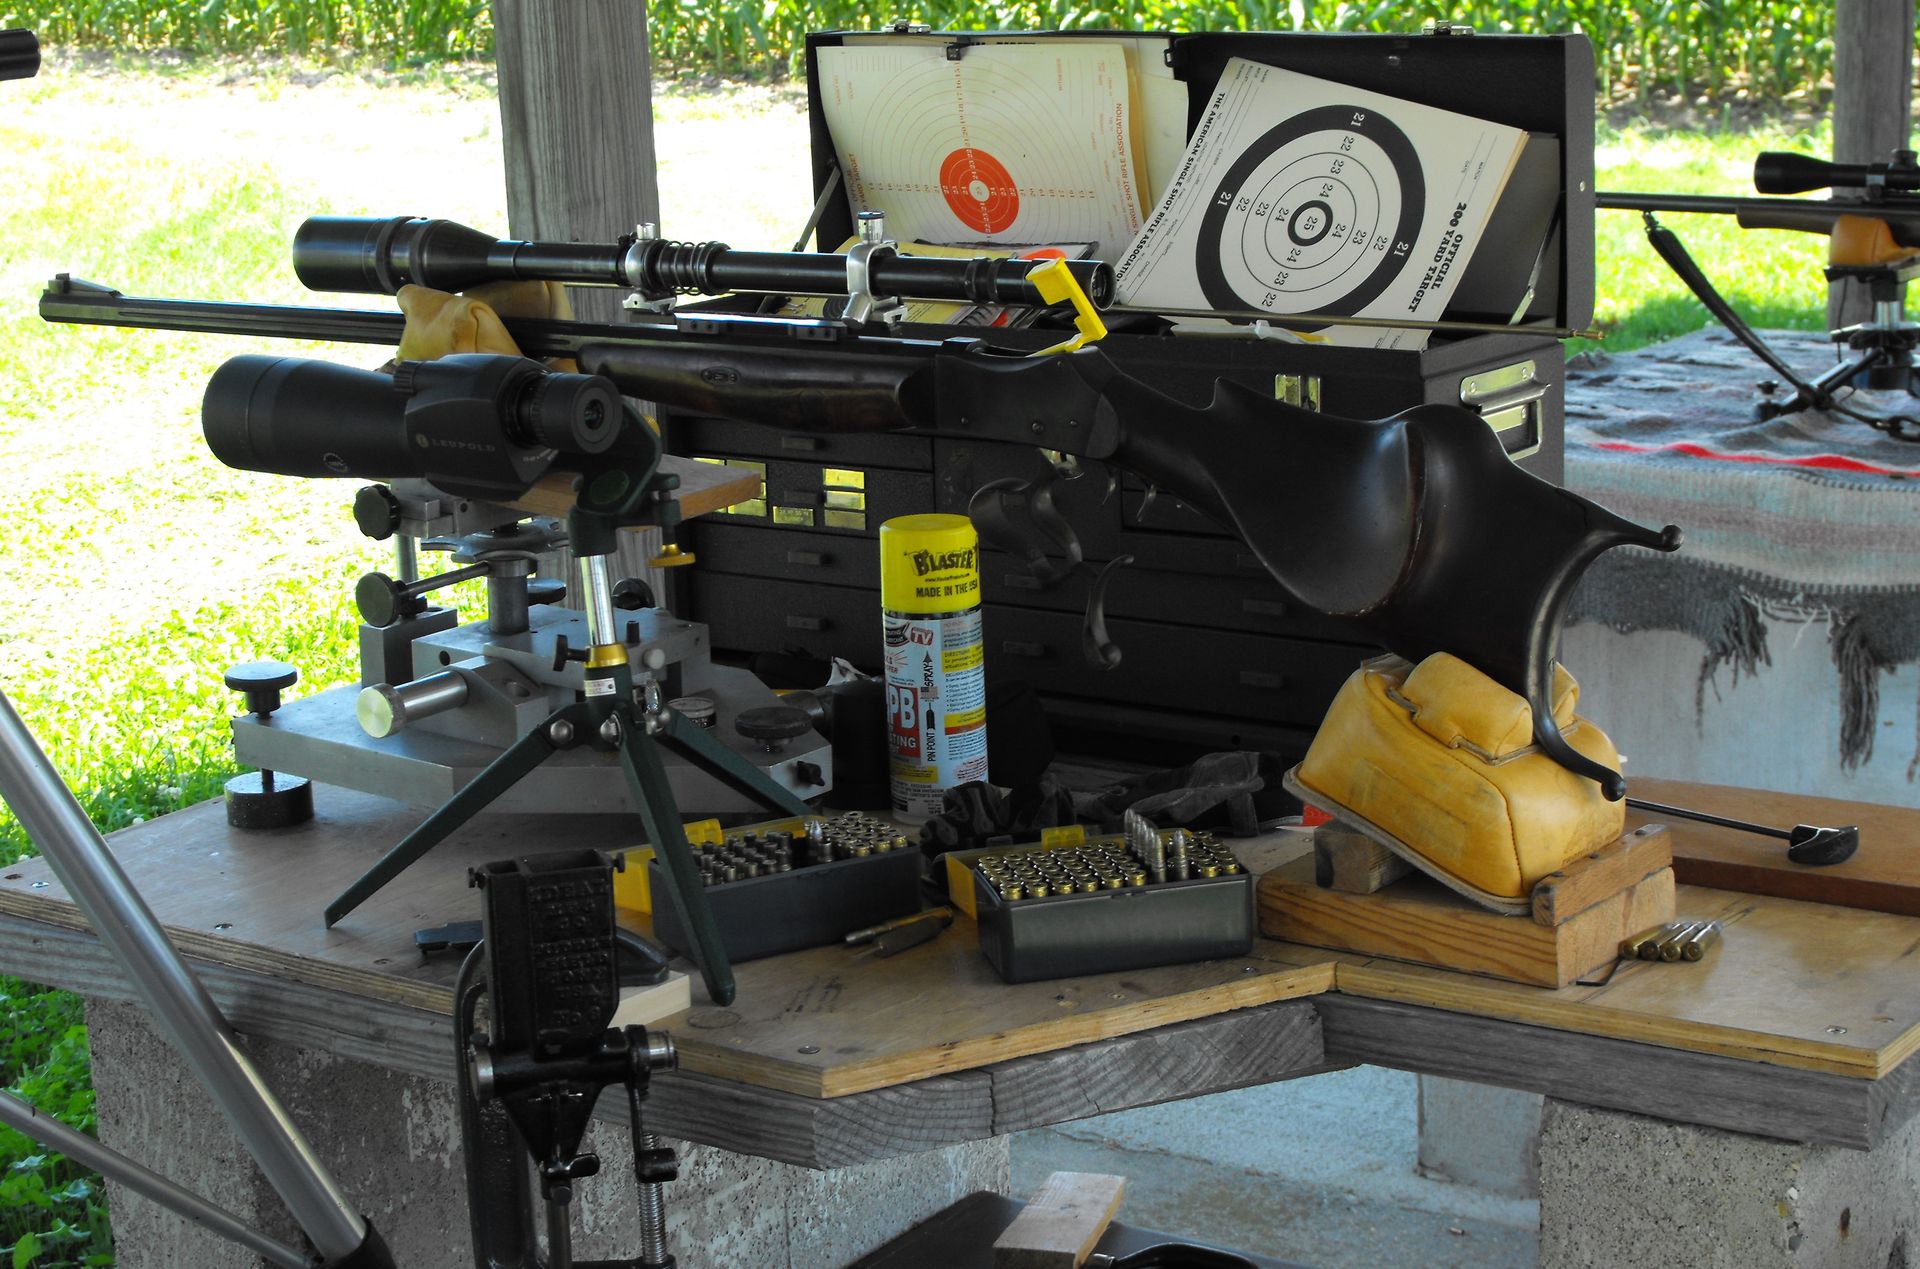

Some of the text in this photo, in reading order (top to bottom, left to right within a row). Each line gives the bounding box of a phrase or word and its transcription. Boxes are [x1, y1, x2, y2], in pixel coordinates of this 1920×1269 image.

[1213, 93, 1225, 109] THE
[1350, 111, 1365, 128] 21
[1114, 102, 1124, 156] ASSOCIATION
[1191, 111, 1216, 155] AMERICAN
[1340, 136, 1353, 151] 22
[1119, 157, 1128, 178] RIFLE
[1175, 157, 1193, 187] SINGLE
[1330, 159, 1344, 174] 23
[1123, 180, 1132, 200] SHOT
[1319, 183, 1333, 197] 24
[1163, 188, 1178, 210] SHOT
[1216, 190, 1231, 207] 21
[1236, 197, 1249, 211] 22
[1255, 202, 1269, 216] 23
[1275, 208, 1289, 221] 24
[1147, 212, 1164, 233] RIFLE
[1304, 216, 1317, 230] 25
[1332, 223, 1345, 238] 24
[1352, 230, 1366, 244] 23
[1373, 236, 1387, 251] 22
[1392, 240, 1409, 258] 21
[1287, 248, 1301, 262] 24
[1408, 202, 1466, 312] 200 YARD TARGET
[1431, 234, 1463, 289] OFFICIAL
[1274, 271, 1288, 285] 23
[1261, 292, 1276, 307] 22
[432, 439, 495, 452] LEUPOLD
[916, 587, 941, 598] MADE
[944, 586, 952, 596] IN
[956, 583, 968, 595] THE
[911, 630, 931, 644] TV
[923, 662, 933, 686] SPRAY
[889, 686, 916, 729] PB
[926, 731, 935, 761] PIN POINT
